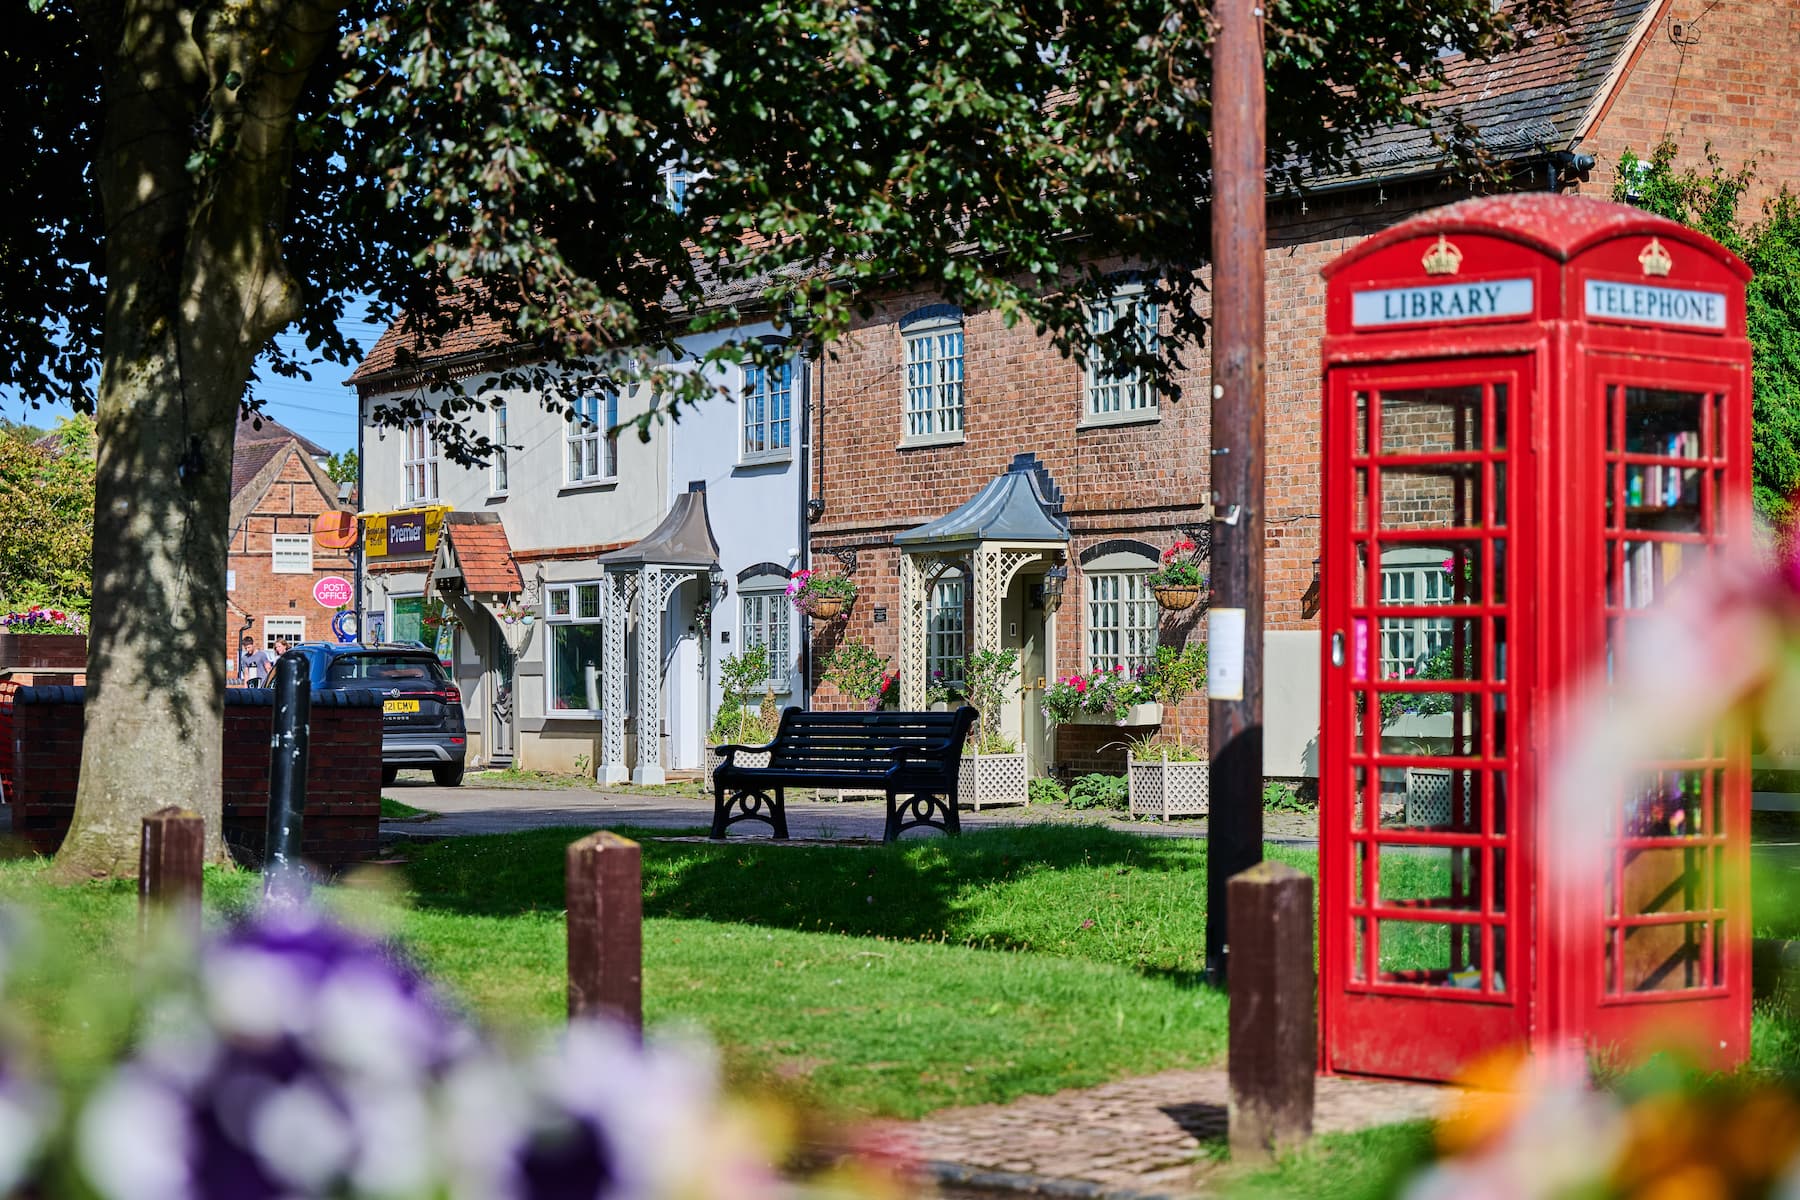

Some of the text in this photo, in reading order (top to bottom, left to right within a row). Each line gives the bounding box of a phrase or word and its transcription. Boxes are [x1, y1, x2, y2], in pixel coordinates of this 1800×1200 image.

[1384, 286, 1502, 320] LIBRARY
[1592, 285, 1717, 322] TELEPHONE
[390, 524, 422, 543] Premier
[323, 583, 345, 592] POST
[318, 591, 348, 600] OFFICE
[397, 701, 414, 711] CMV
